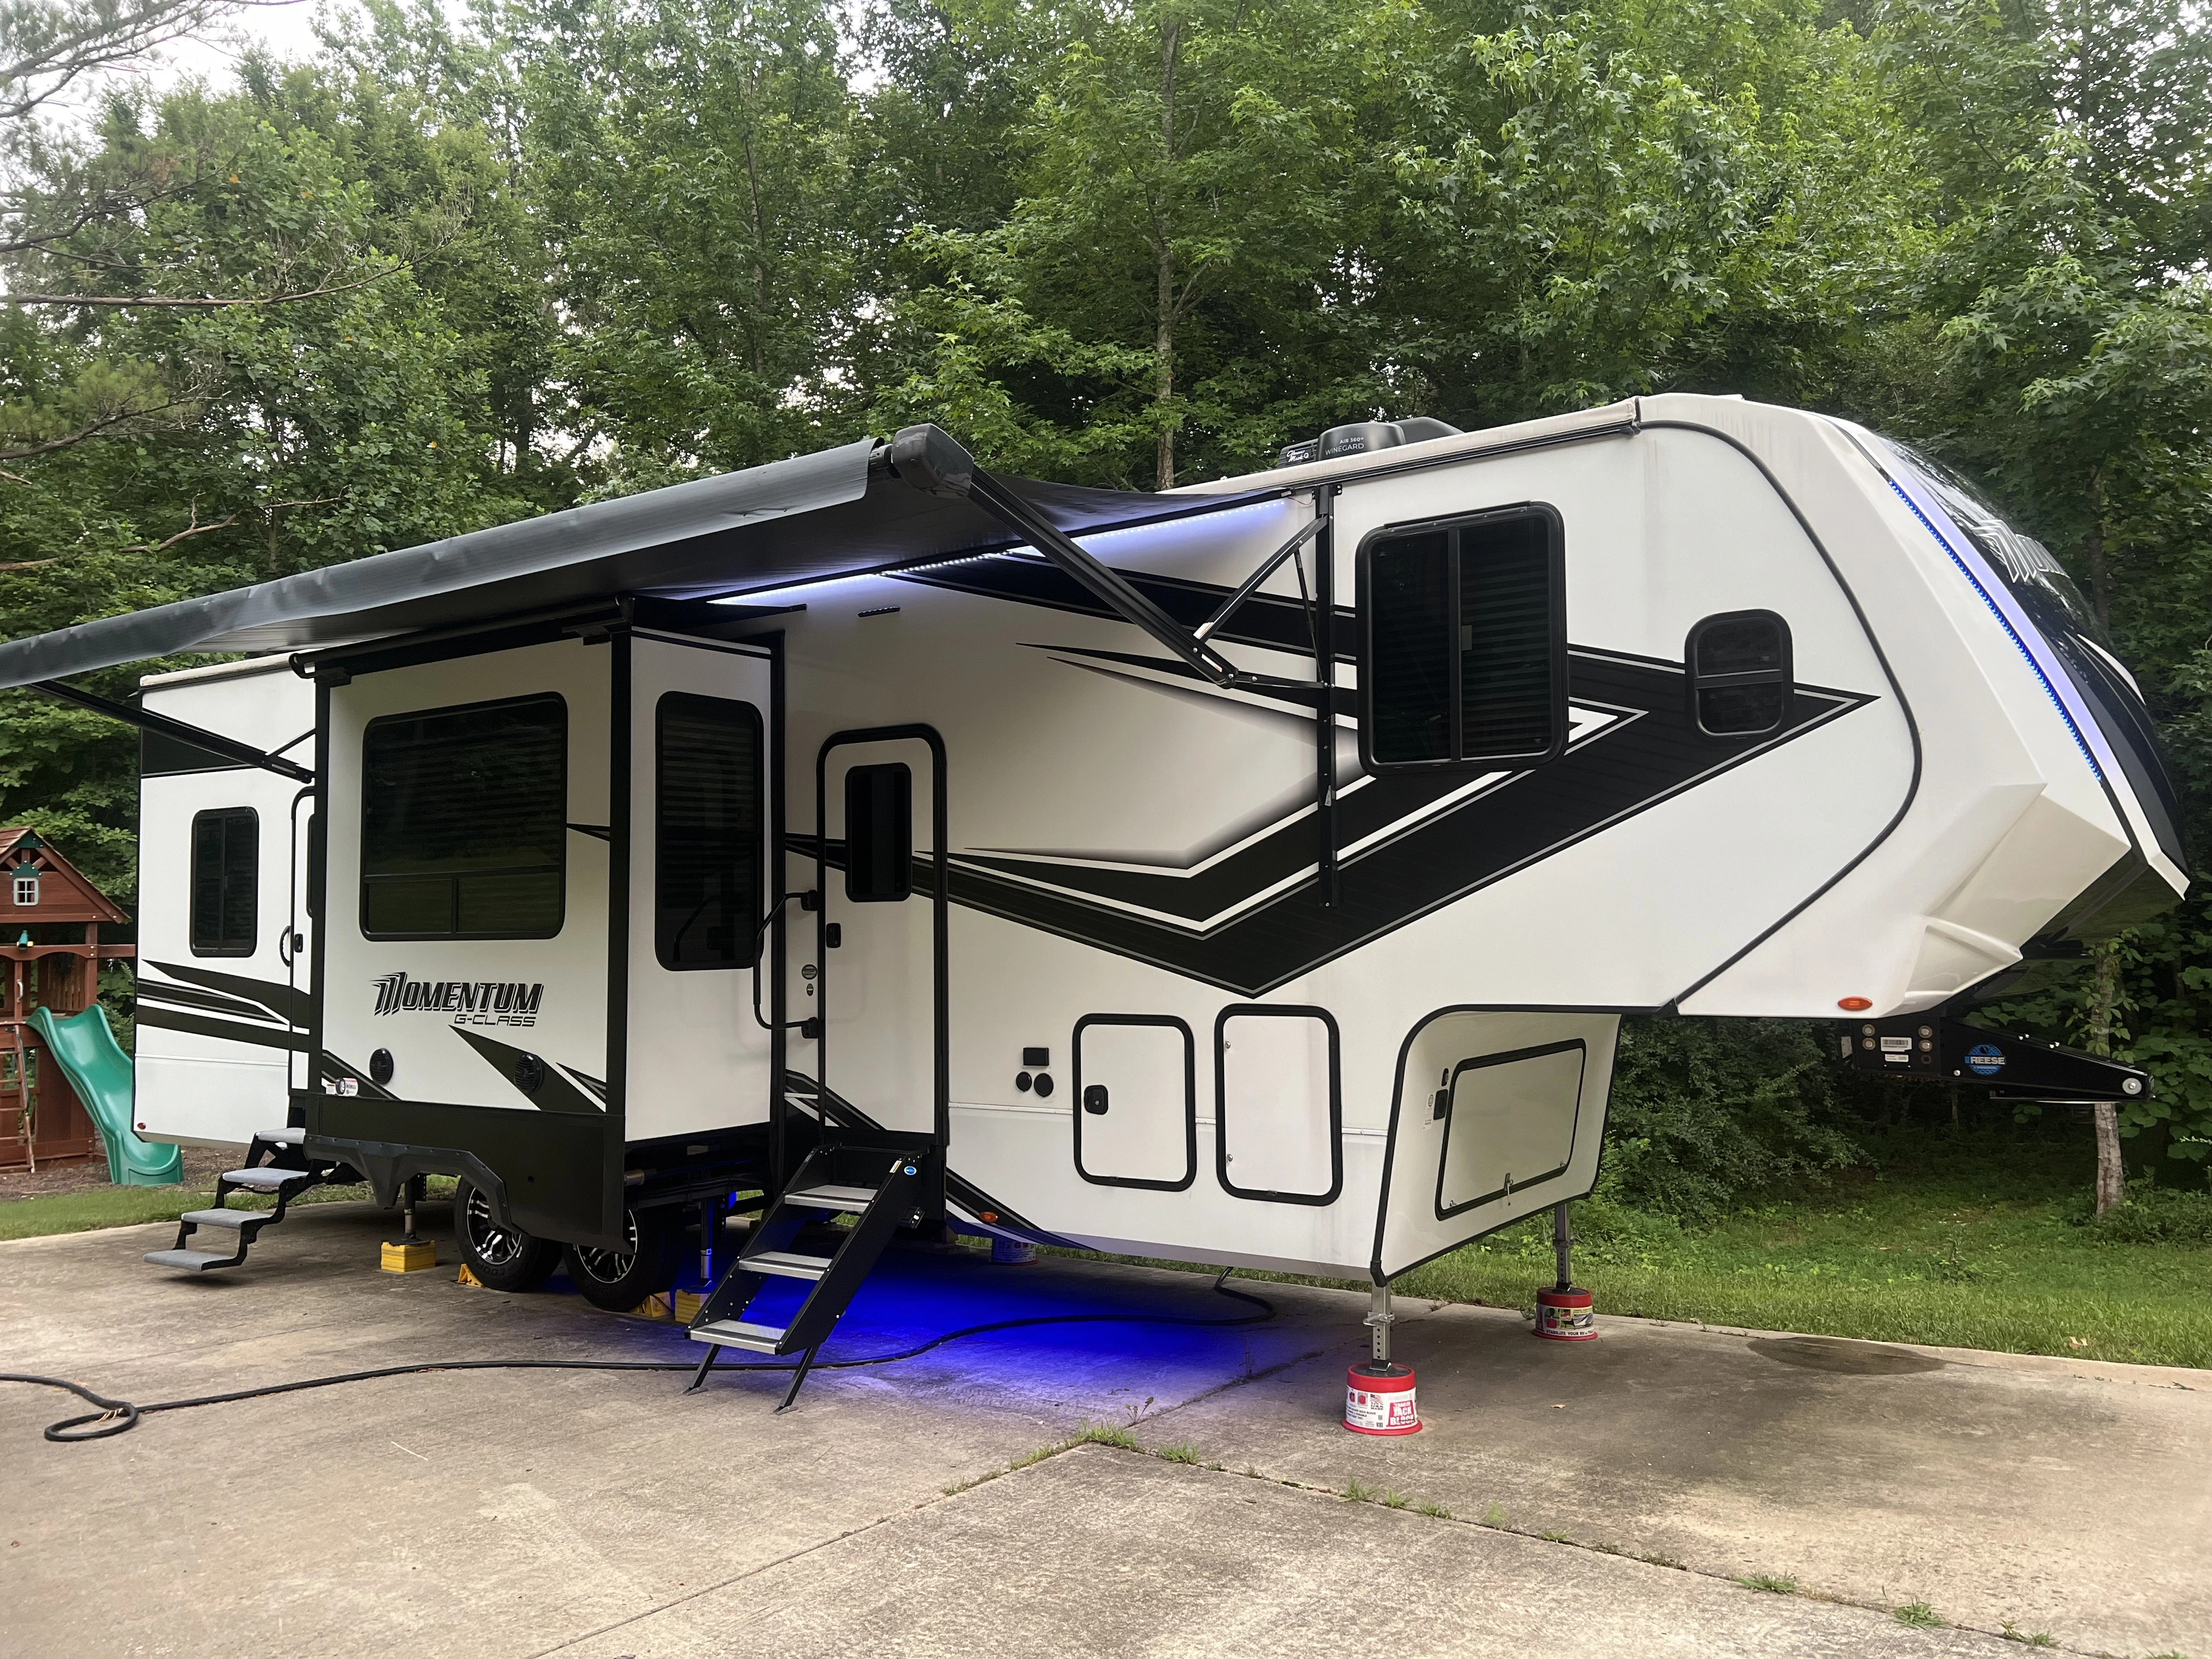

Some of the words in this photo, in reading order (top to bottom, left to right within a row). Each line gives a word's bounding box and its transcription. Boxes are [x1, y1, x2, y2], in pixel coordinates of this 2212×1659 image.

[1325, 443, 1364, 455] WINEGARD
[369, 971, 544, 1017] MOMENTUM
[454, 1014, 537, 1027] G-CLASS
[1970, 1056, 2005, 1065] REESE
[1393, 1406, 1412, 1417] JACK
[1390, 1414, 1415, 1426] BLOCK
